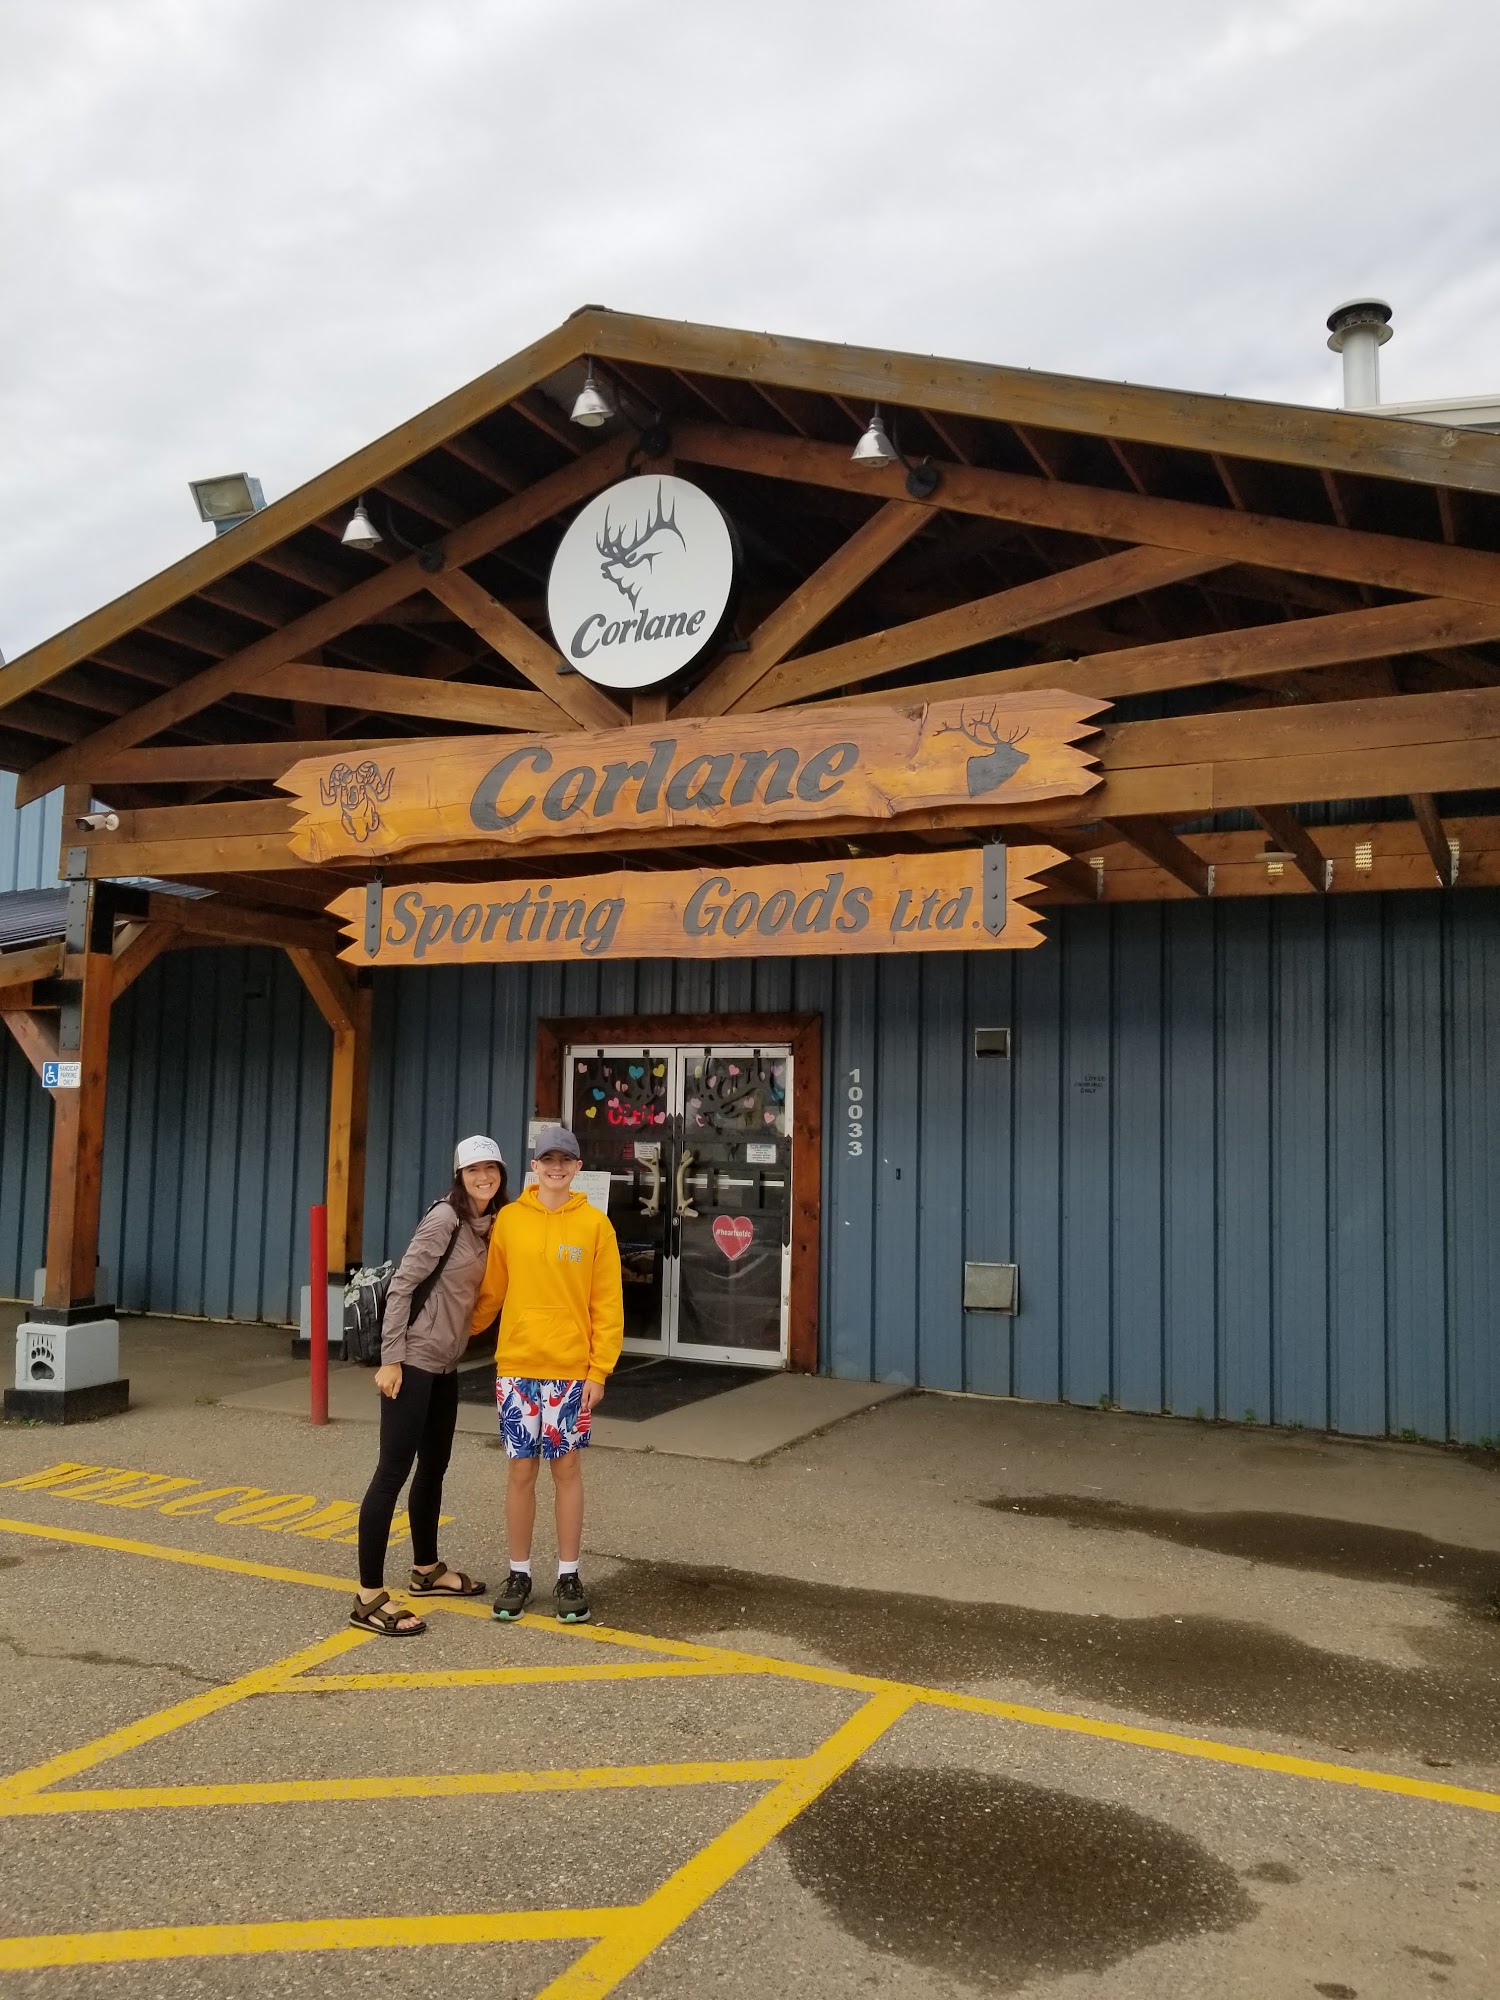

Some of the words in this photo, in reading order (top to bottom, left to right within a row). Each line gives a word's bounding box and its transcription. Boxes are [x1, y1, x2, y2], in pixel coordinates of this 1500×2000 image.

[571, 609, 705, 658] Corlane
[470, 739, 859, 831] Corlane
[386, 885, 625, 959] Sporting
[683, 872, 872, 936] Goods
[890, 887, 980, 932] Ltd.
[848, 1068, 863, 1156] 10033
